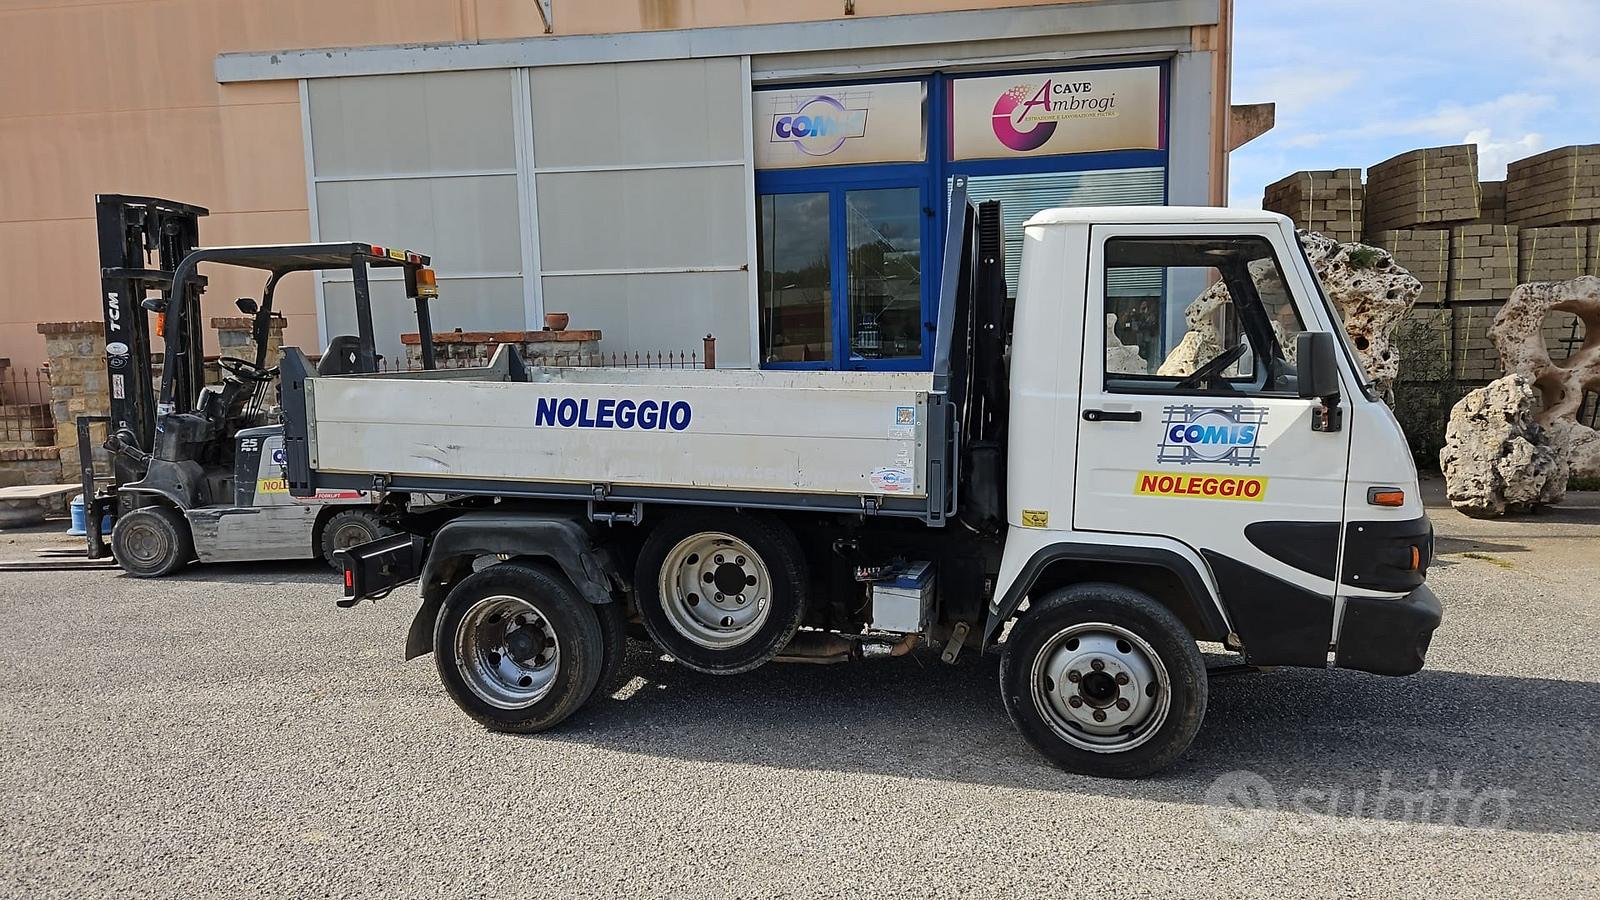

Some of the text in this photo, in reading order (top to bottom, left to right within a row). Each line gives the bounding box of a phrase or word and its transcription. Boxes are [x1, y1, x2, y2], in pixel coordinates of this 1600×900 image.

[1053, 82, 1092, 94] CAVE
[1017, 79, 1116, 123] Ambrogi
[107, 292, 121, 332] TCM
[535, 397, 692, 431] NOLEGGIO
[241, 438, 258, 448] 25
[1169, 424, 1256, 445] COMIS
[263, 481, 288, 491] NOL
[1140, 475, 1261, 498] NOLEGGIO
